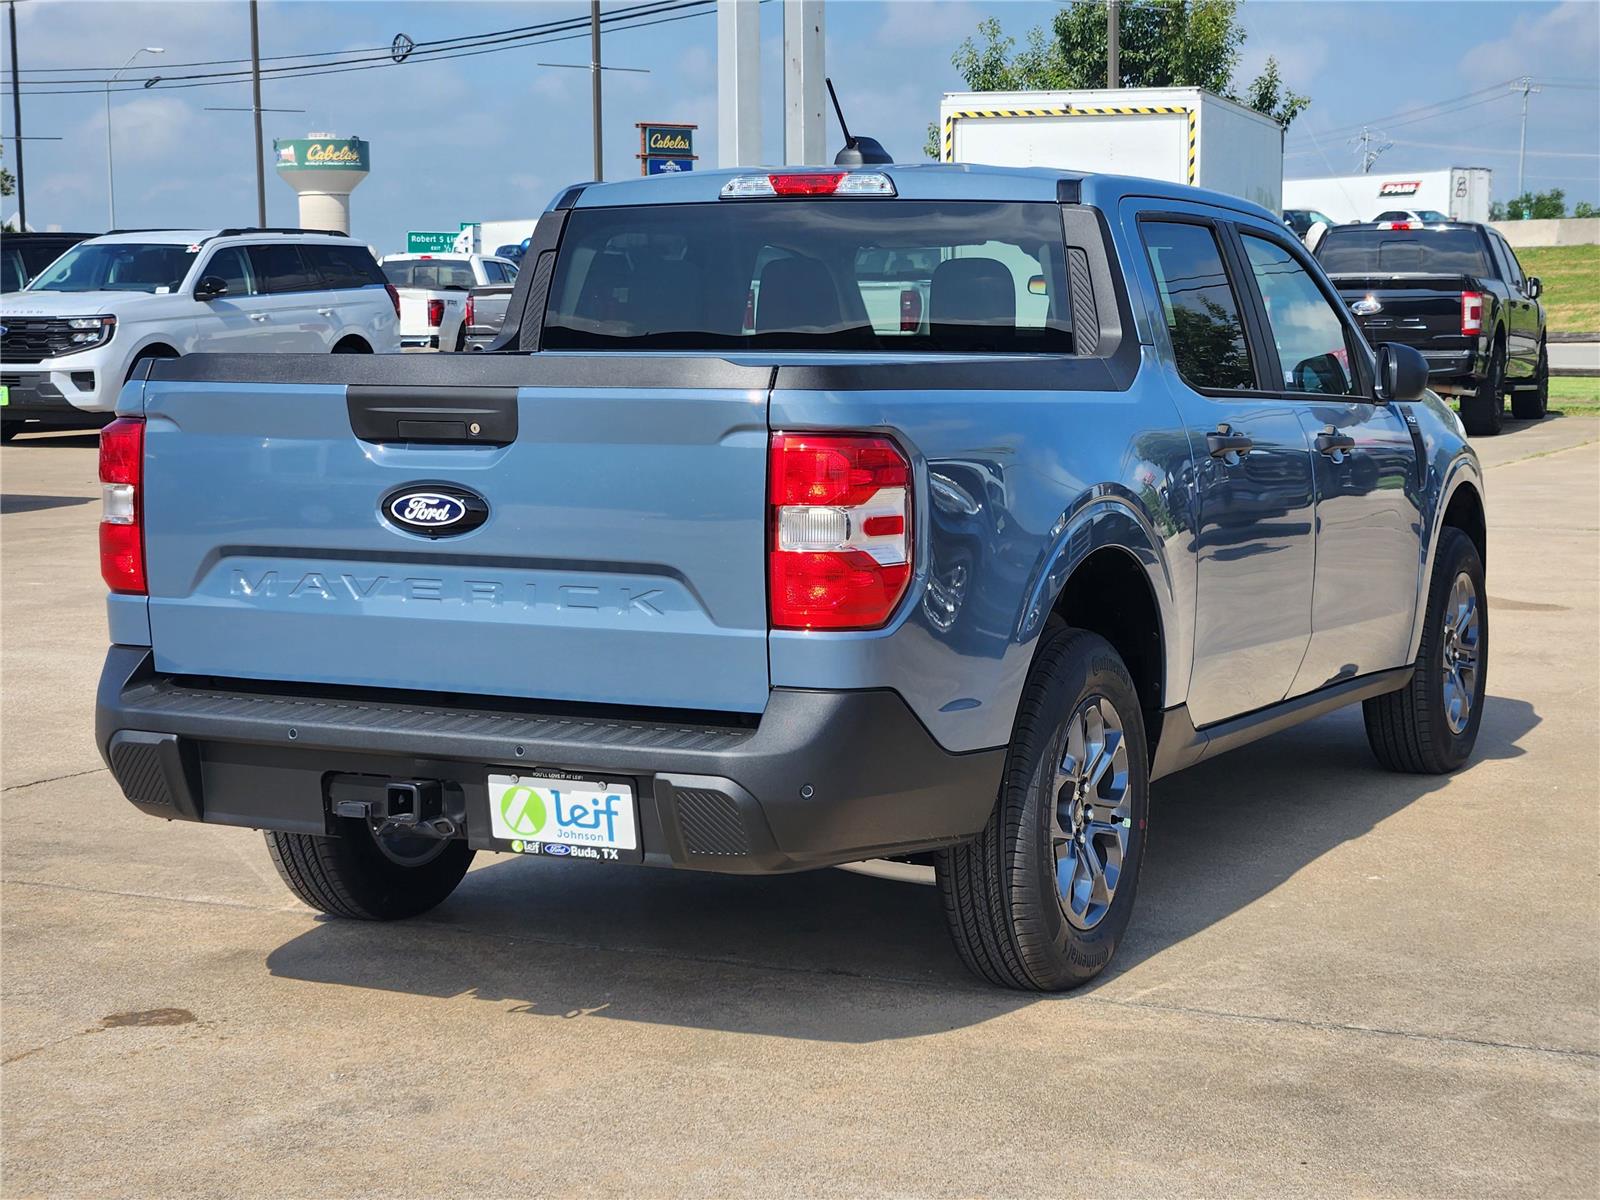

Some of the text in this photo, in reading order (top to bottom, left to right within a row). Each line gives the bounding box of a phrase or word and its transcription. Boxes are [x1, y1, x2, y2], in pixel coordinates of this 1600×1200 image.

[651, 134, 690, 149] Cabela's
[1384, 184, 1418, 193] PAM
[411, 235, 436, 243] Robert
[404, 497, 451, 521] Ford
[230, 569, 665, 616] MAVERICK
[556, 829, 604, 842] Johnson
[570, 846, 600, 859] Buda,
[602, 848, 619, 860] TX
